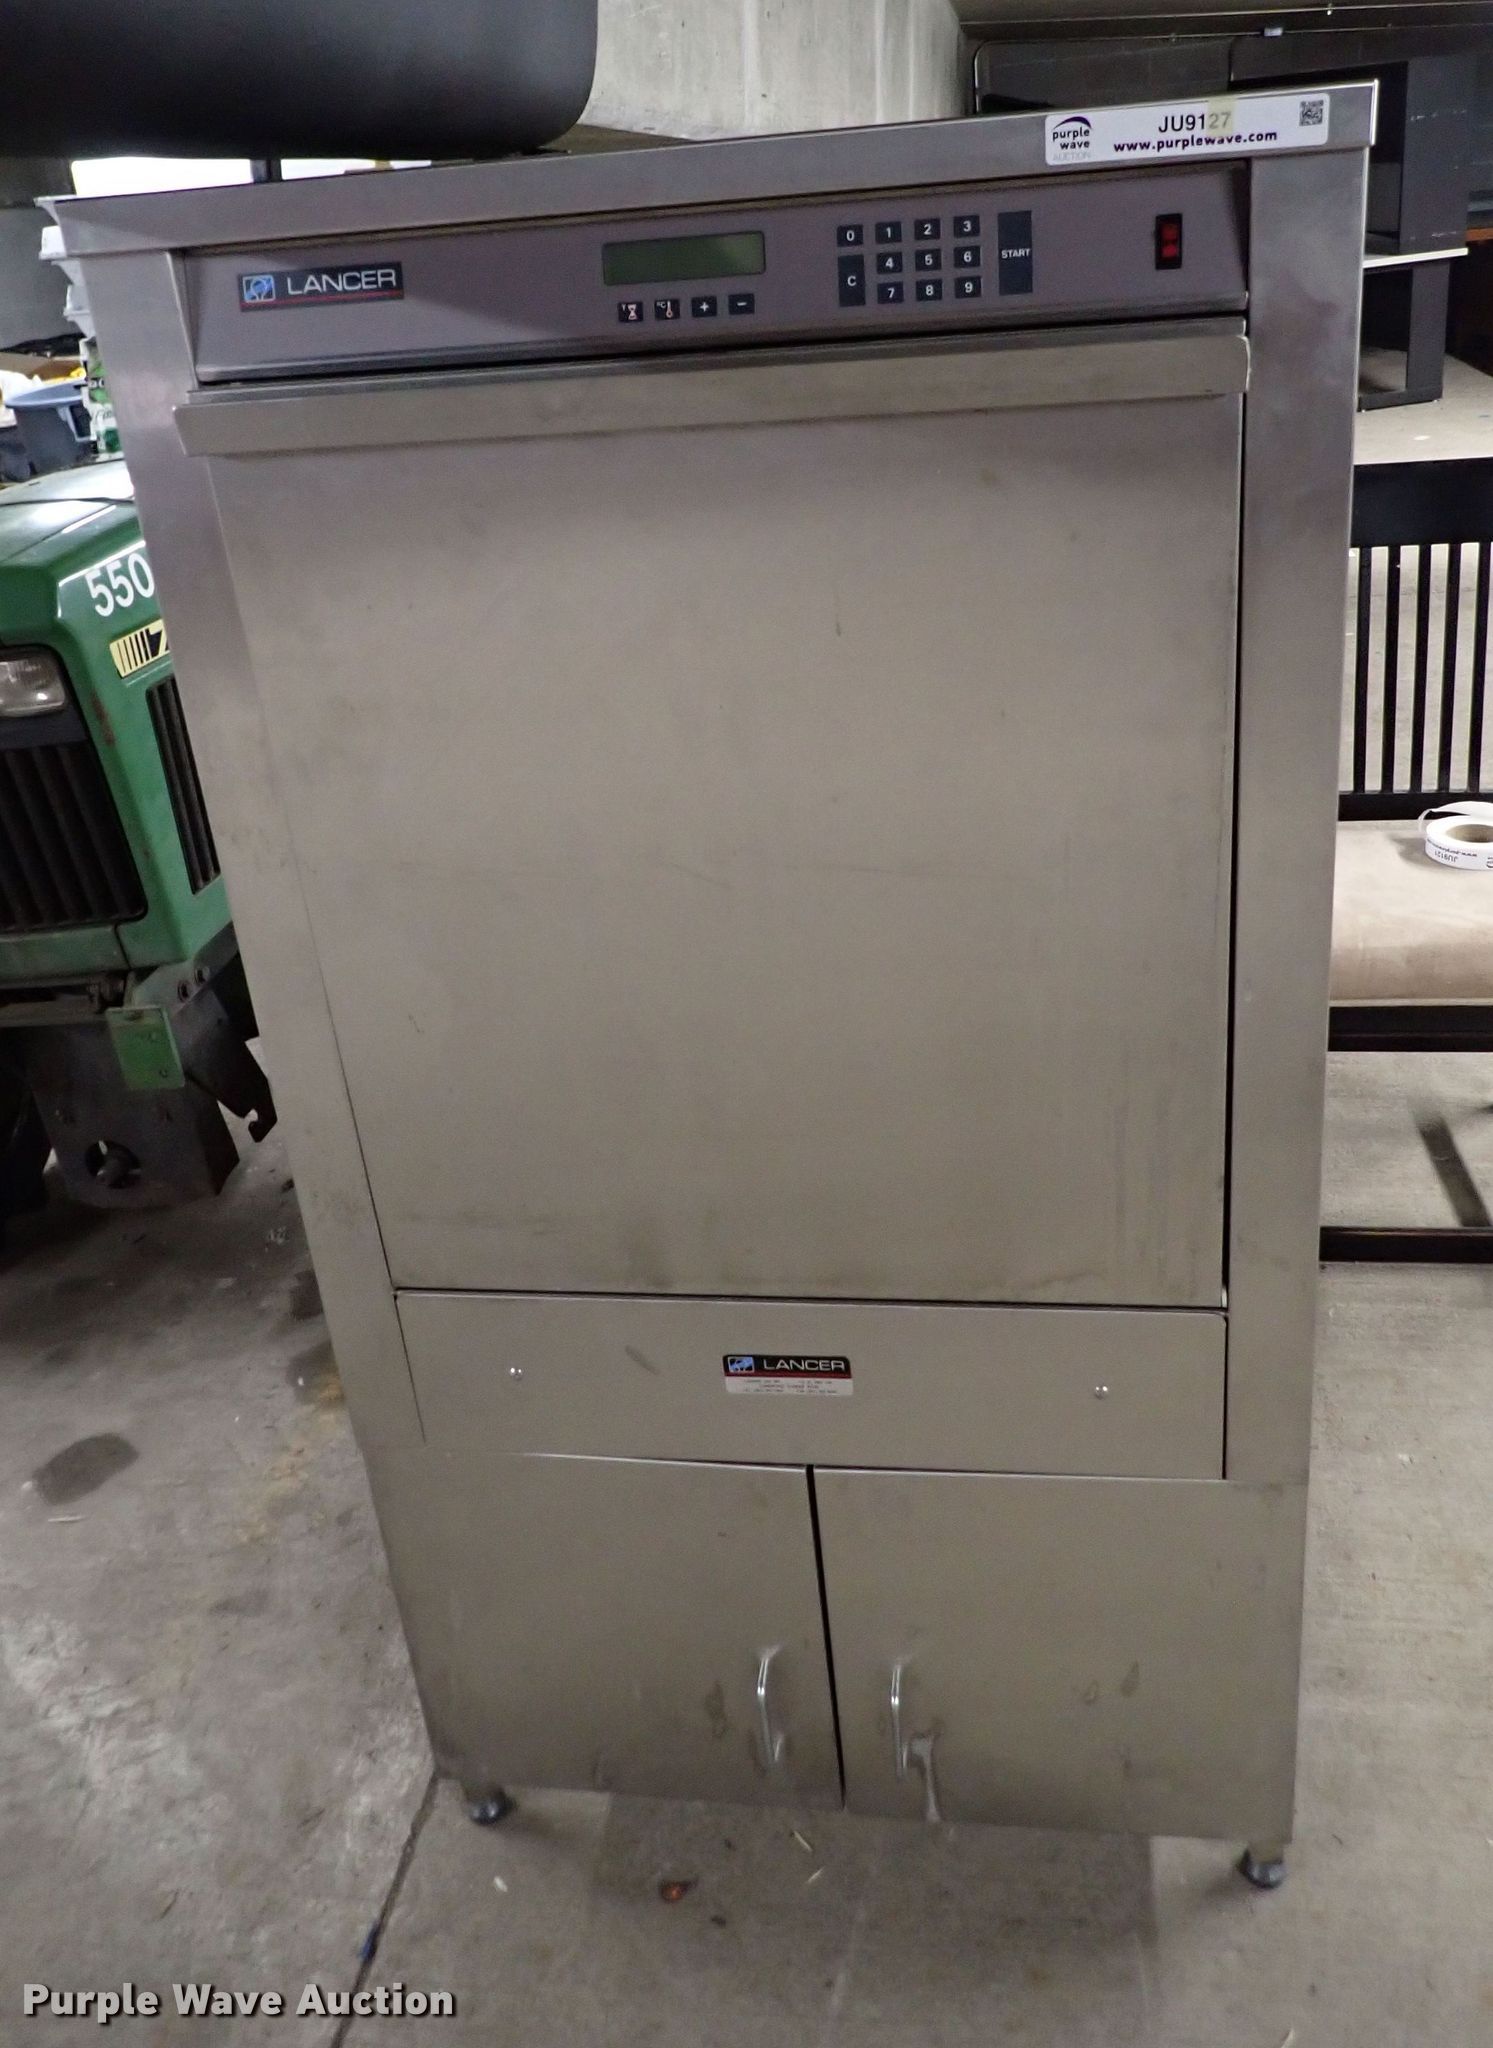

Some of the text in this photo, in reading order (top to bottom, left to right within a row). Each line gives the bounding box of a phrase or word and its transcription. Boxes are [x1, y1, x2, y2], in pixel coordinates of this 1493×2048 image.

[1158, 111, 1232, 134] JU9127
[1052, 127, 1091, 142] purple
[1113, 130, 1278, 153] www.purplewave.com
[1060, 139, 1091, 151] wave
[885, 226, 892, 239] 1
[923, 223, 933, 236] 2
[963, 220, 972, 233] 3
[885, 251, 972, 269] 4 5 6
[1001, 248, 1031, 260] START
[287, 268, 397, 296] LANCER
[847, 275, 857, 287] C
[887, 281, 973, 299] 7 8 9
[84, 552, 155, 617] 550
[763, 1359, 846, 1372] LANCER
